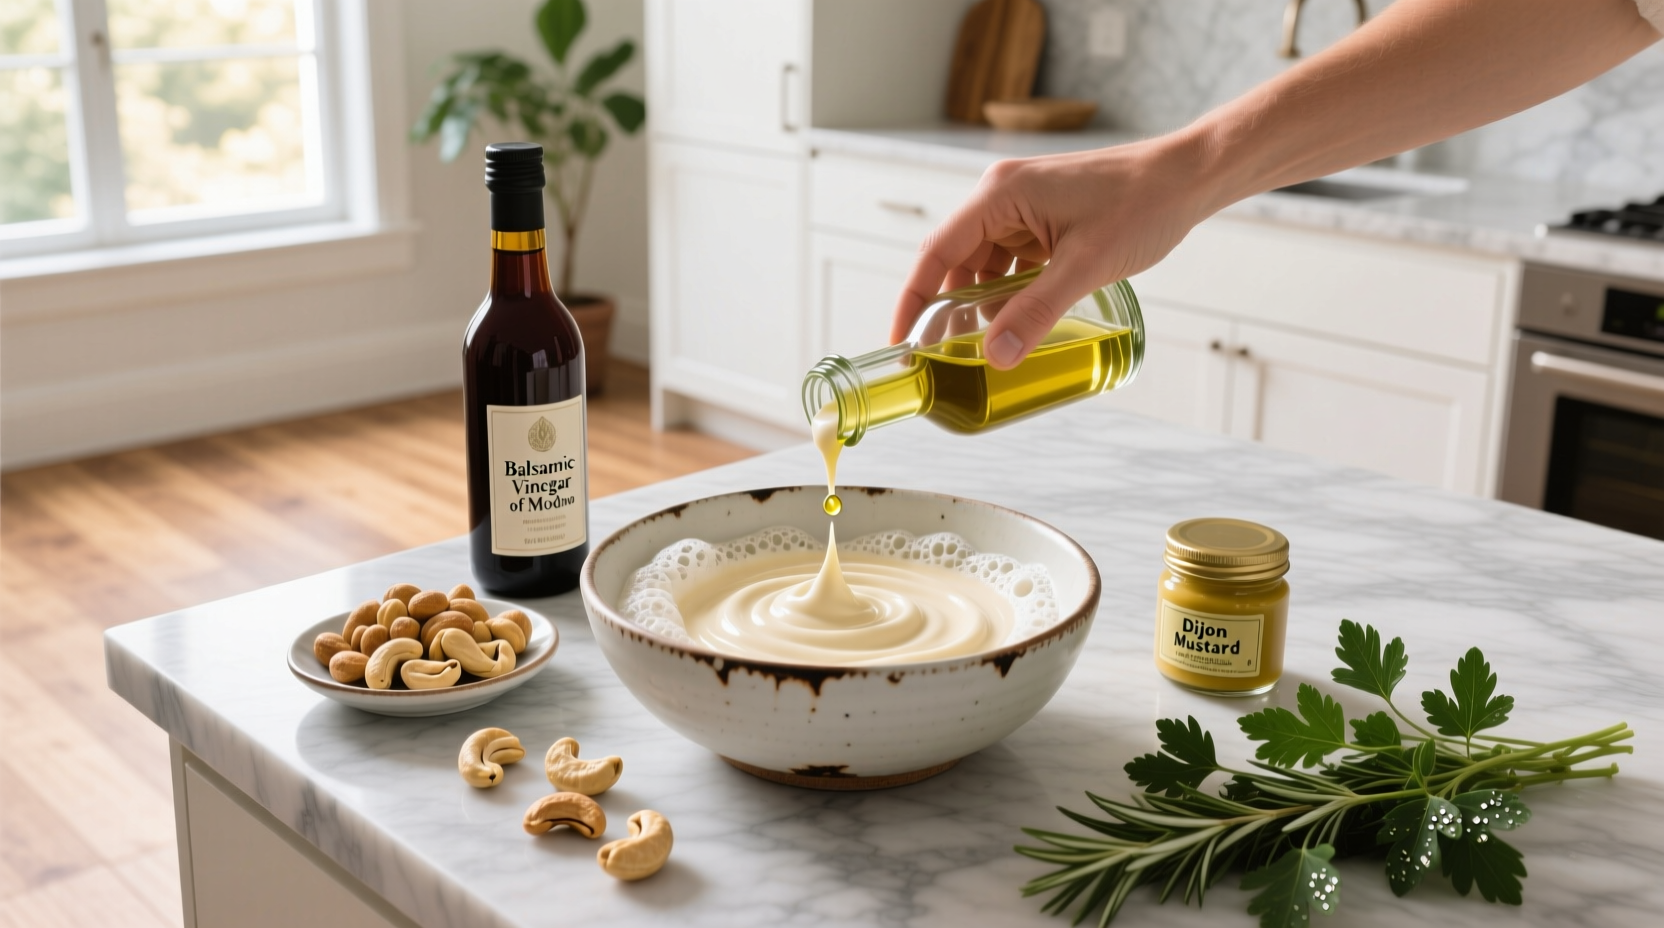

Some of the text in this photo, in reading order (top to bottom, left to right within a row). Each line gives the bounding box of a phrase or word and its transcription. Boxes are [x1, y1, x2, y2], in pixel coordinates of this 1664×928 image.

[504, 455, 575, 476] Balsamic
[510, 498, 525, 512] of
[1183, 618, 1227, 640] Dijon
[1174, 632, 1240, 654] Mustard
